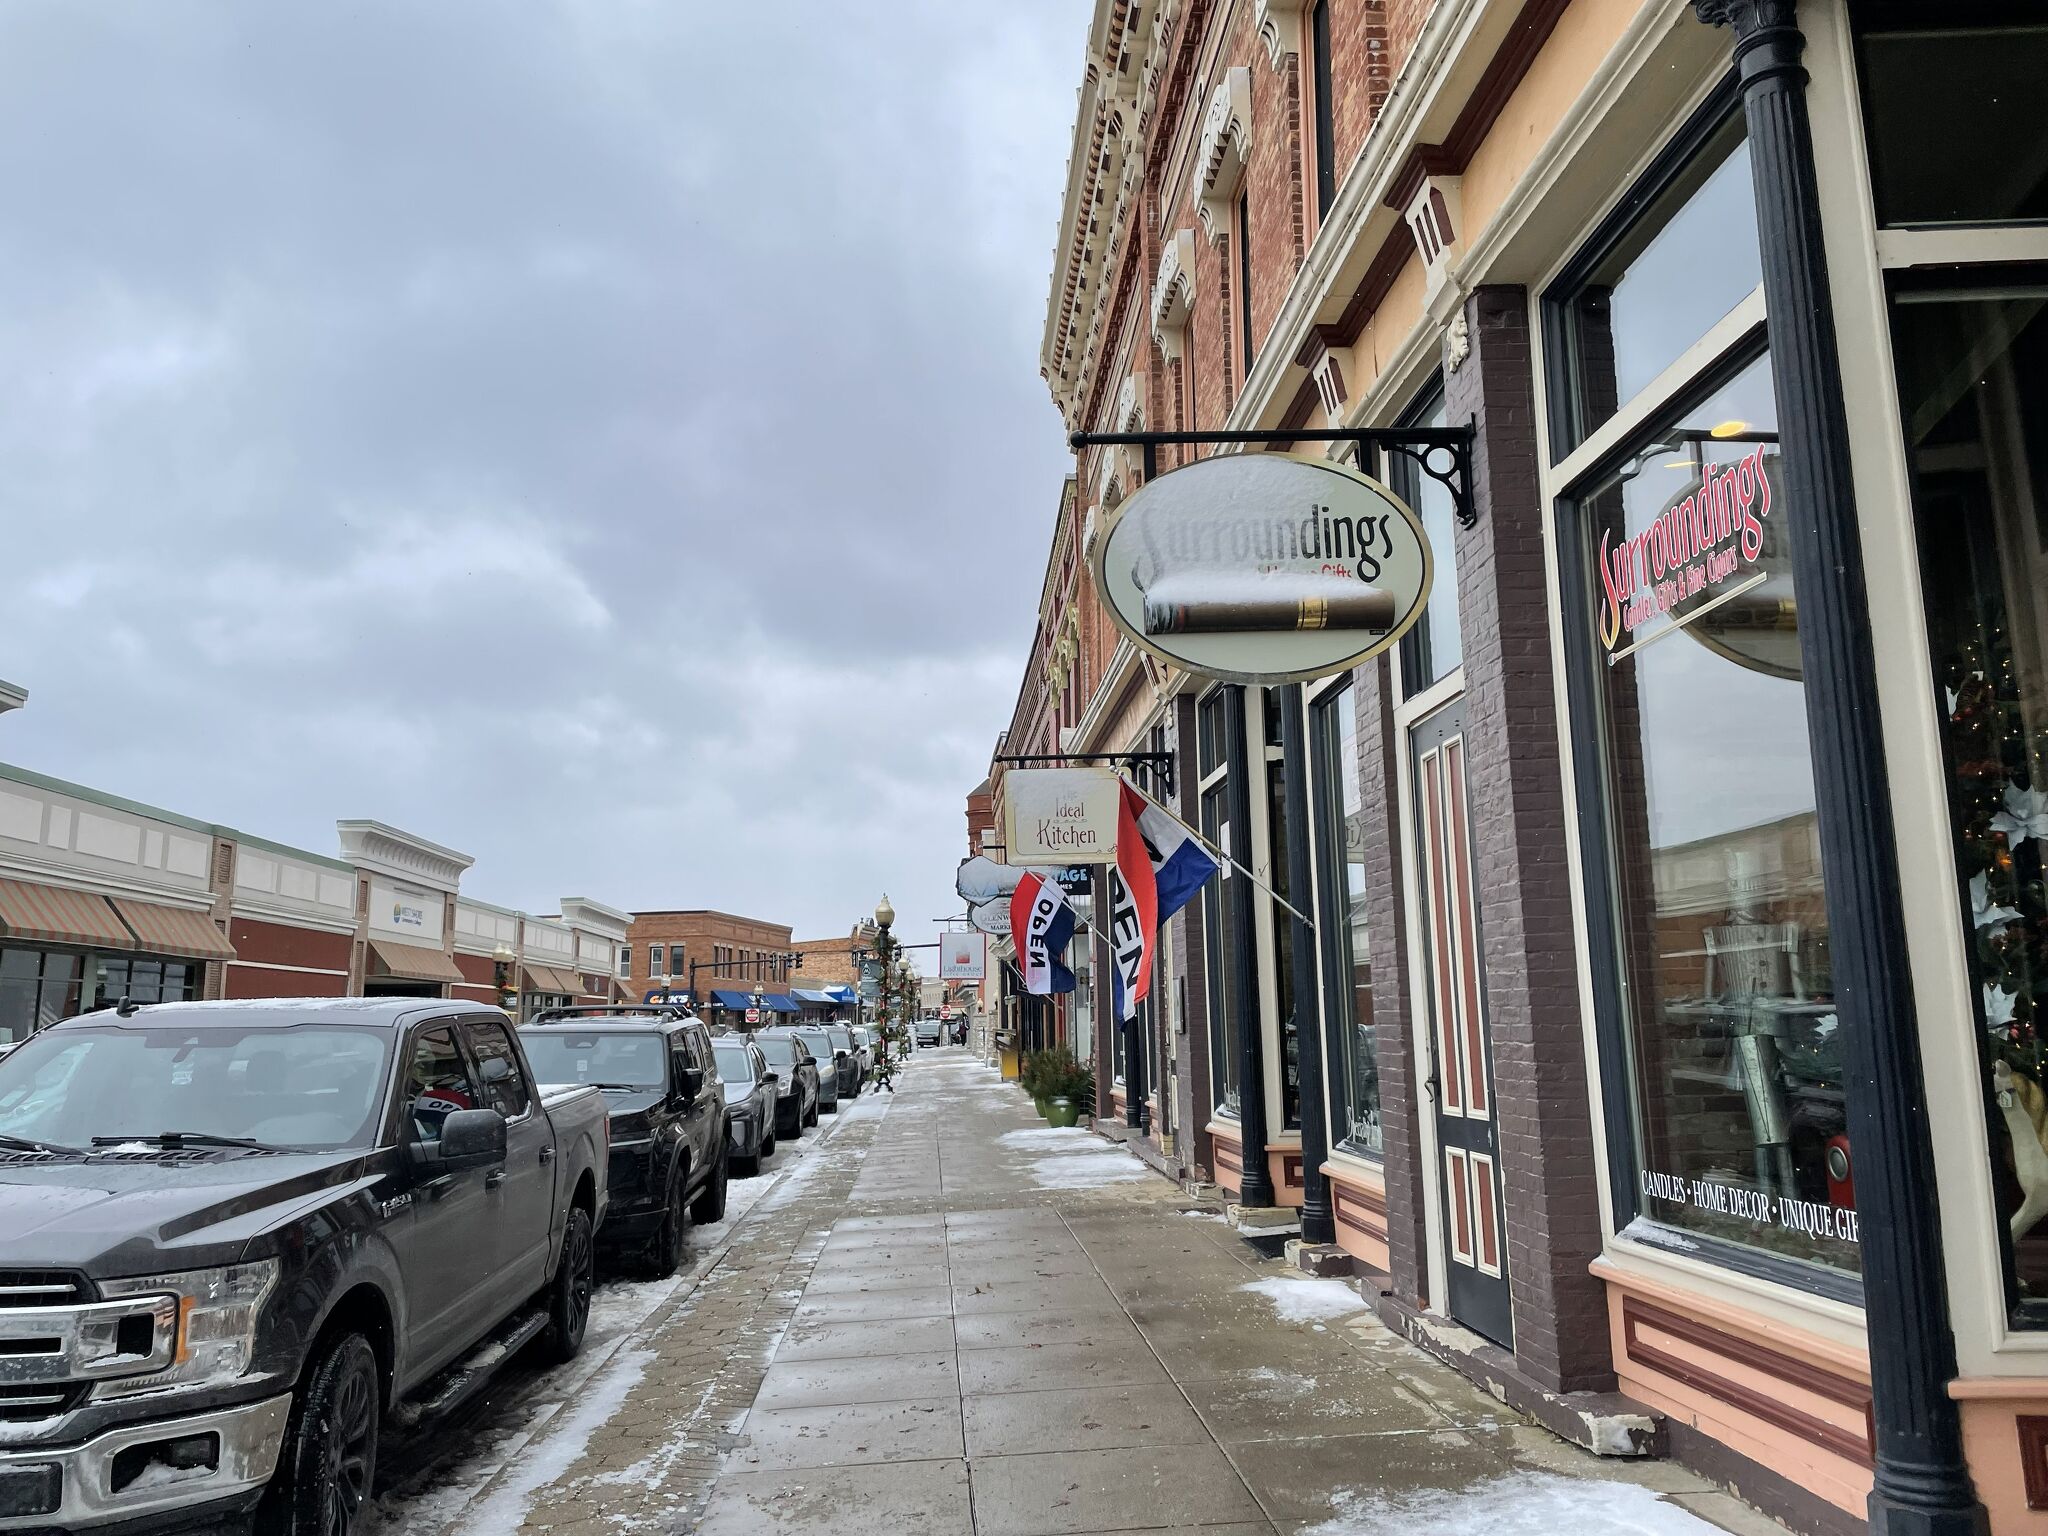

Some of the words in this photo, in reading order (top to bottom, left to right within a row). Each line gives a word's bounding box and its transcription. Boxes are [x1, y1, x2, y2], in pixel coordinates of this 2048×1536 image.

[1598, 443, 1771, 650] Surroundings
[1677, 570, 1687, 601] &
[1686, 563, 1706, 596] Fine
[1706, 545, 1738, 583] Cigars
[1036, 819, 1096, 850] Kitchen
[1056, 797, 1085, 818] Ideal
[1641, 1169, 1686, 1204] CANDLES
[1691, 1179, 1728, 1213] HOME
[1728, 1187, 1772, 1223] DECOR
[1778, 1196, 1834, 1240] UNIQUE
[1835, 1207, 1860, 1243] GIF
